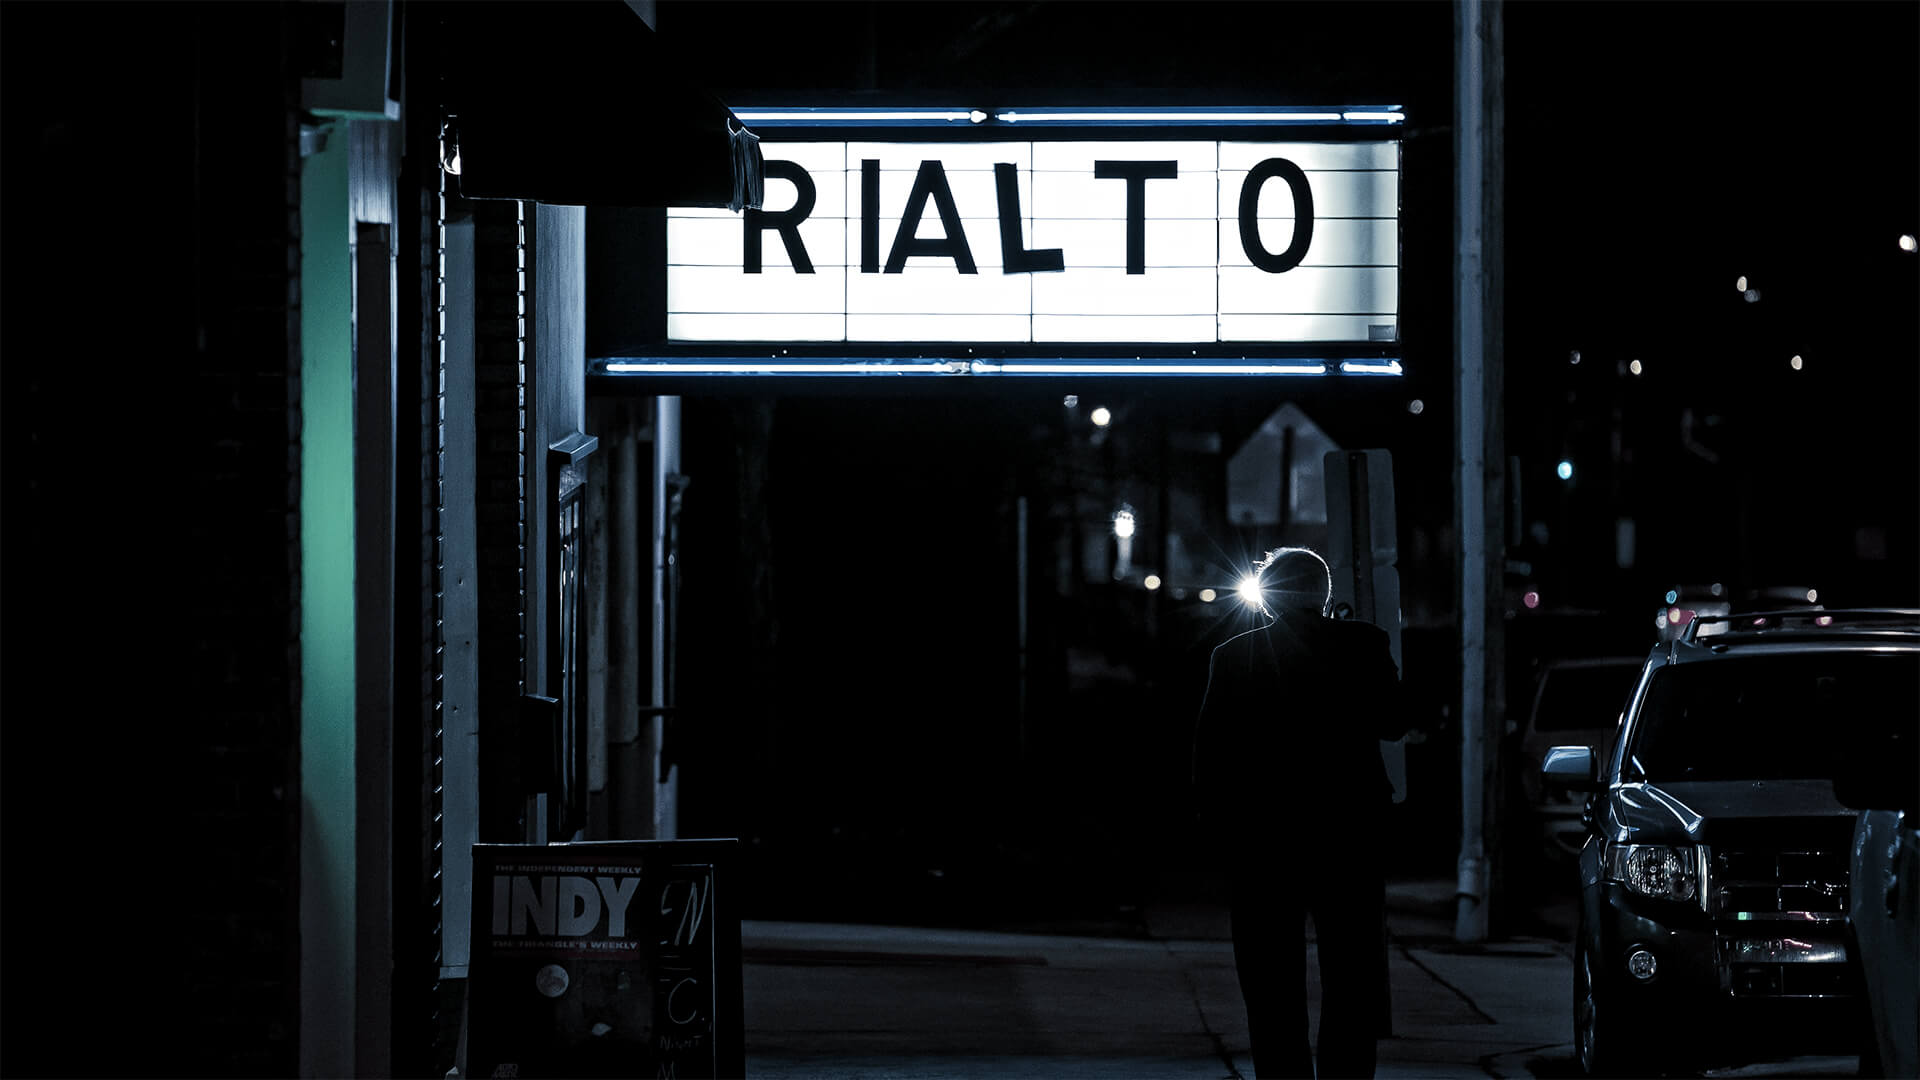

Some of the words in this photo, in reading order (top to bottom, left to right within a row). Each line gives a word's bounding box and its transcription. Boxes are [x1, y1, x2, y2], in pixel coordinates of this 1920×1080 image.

[743, 157, 1315, 275] RIALTO
[495, 864, 513, 873] THE
[518, 864, 595, 874] INDEPENDENT
[597, 865, 641, 875] WEEKLY
[491, 874, 641, 937] INDY
[590, 941, 639, 951] WEEKLY
